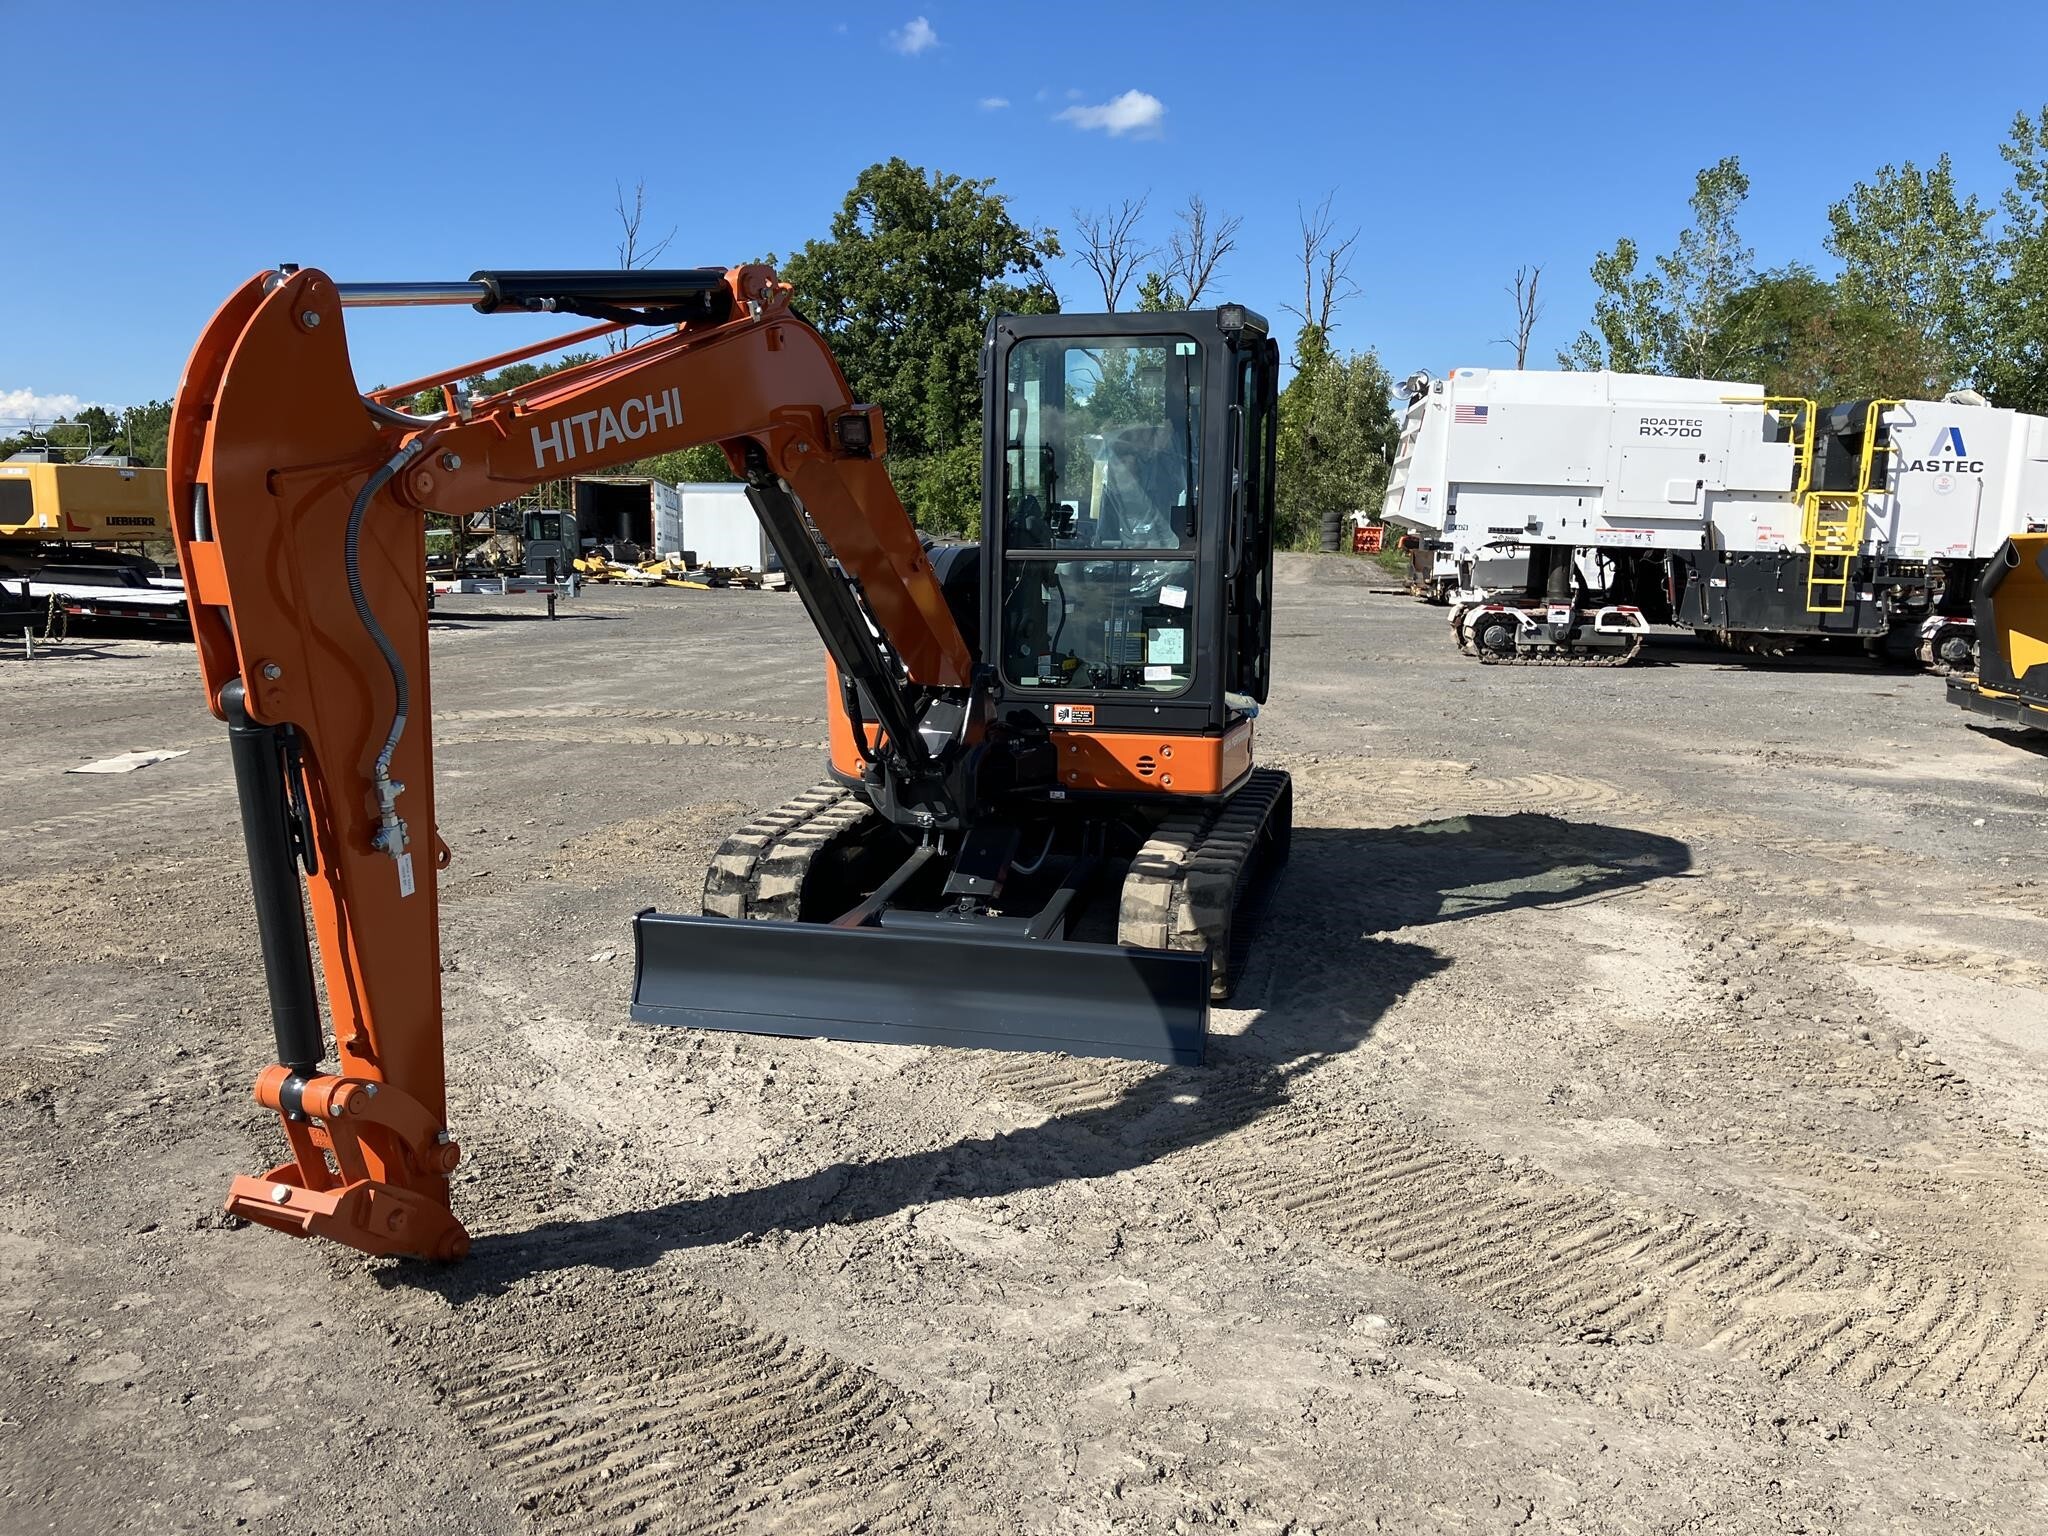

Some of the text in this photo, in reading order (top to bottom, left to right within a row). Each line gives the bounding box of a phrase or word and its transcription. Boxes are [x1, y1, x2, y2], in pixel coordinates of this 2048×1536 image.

[530, 387, 684, 469] HITACHI
[1640, 417, 1703, 427] ROADTEC
[1640, 426, 1702, 438] RX-700
[1909, 459, 1984, 473] ASTEC
[106, 516, 155, 527] LIEBHERR
